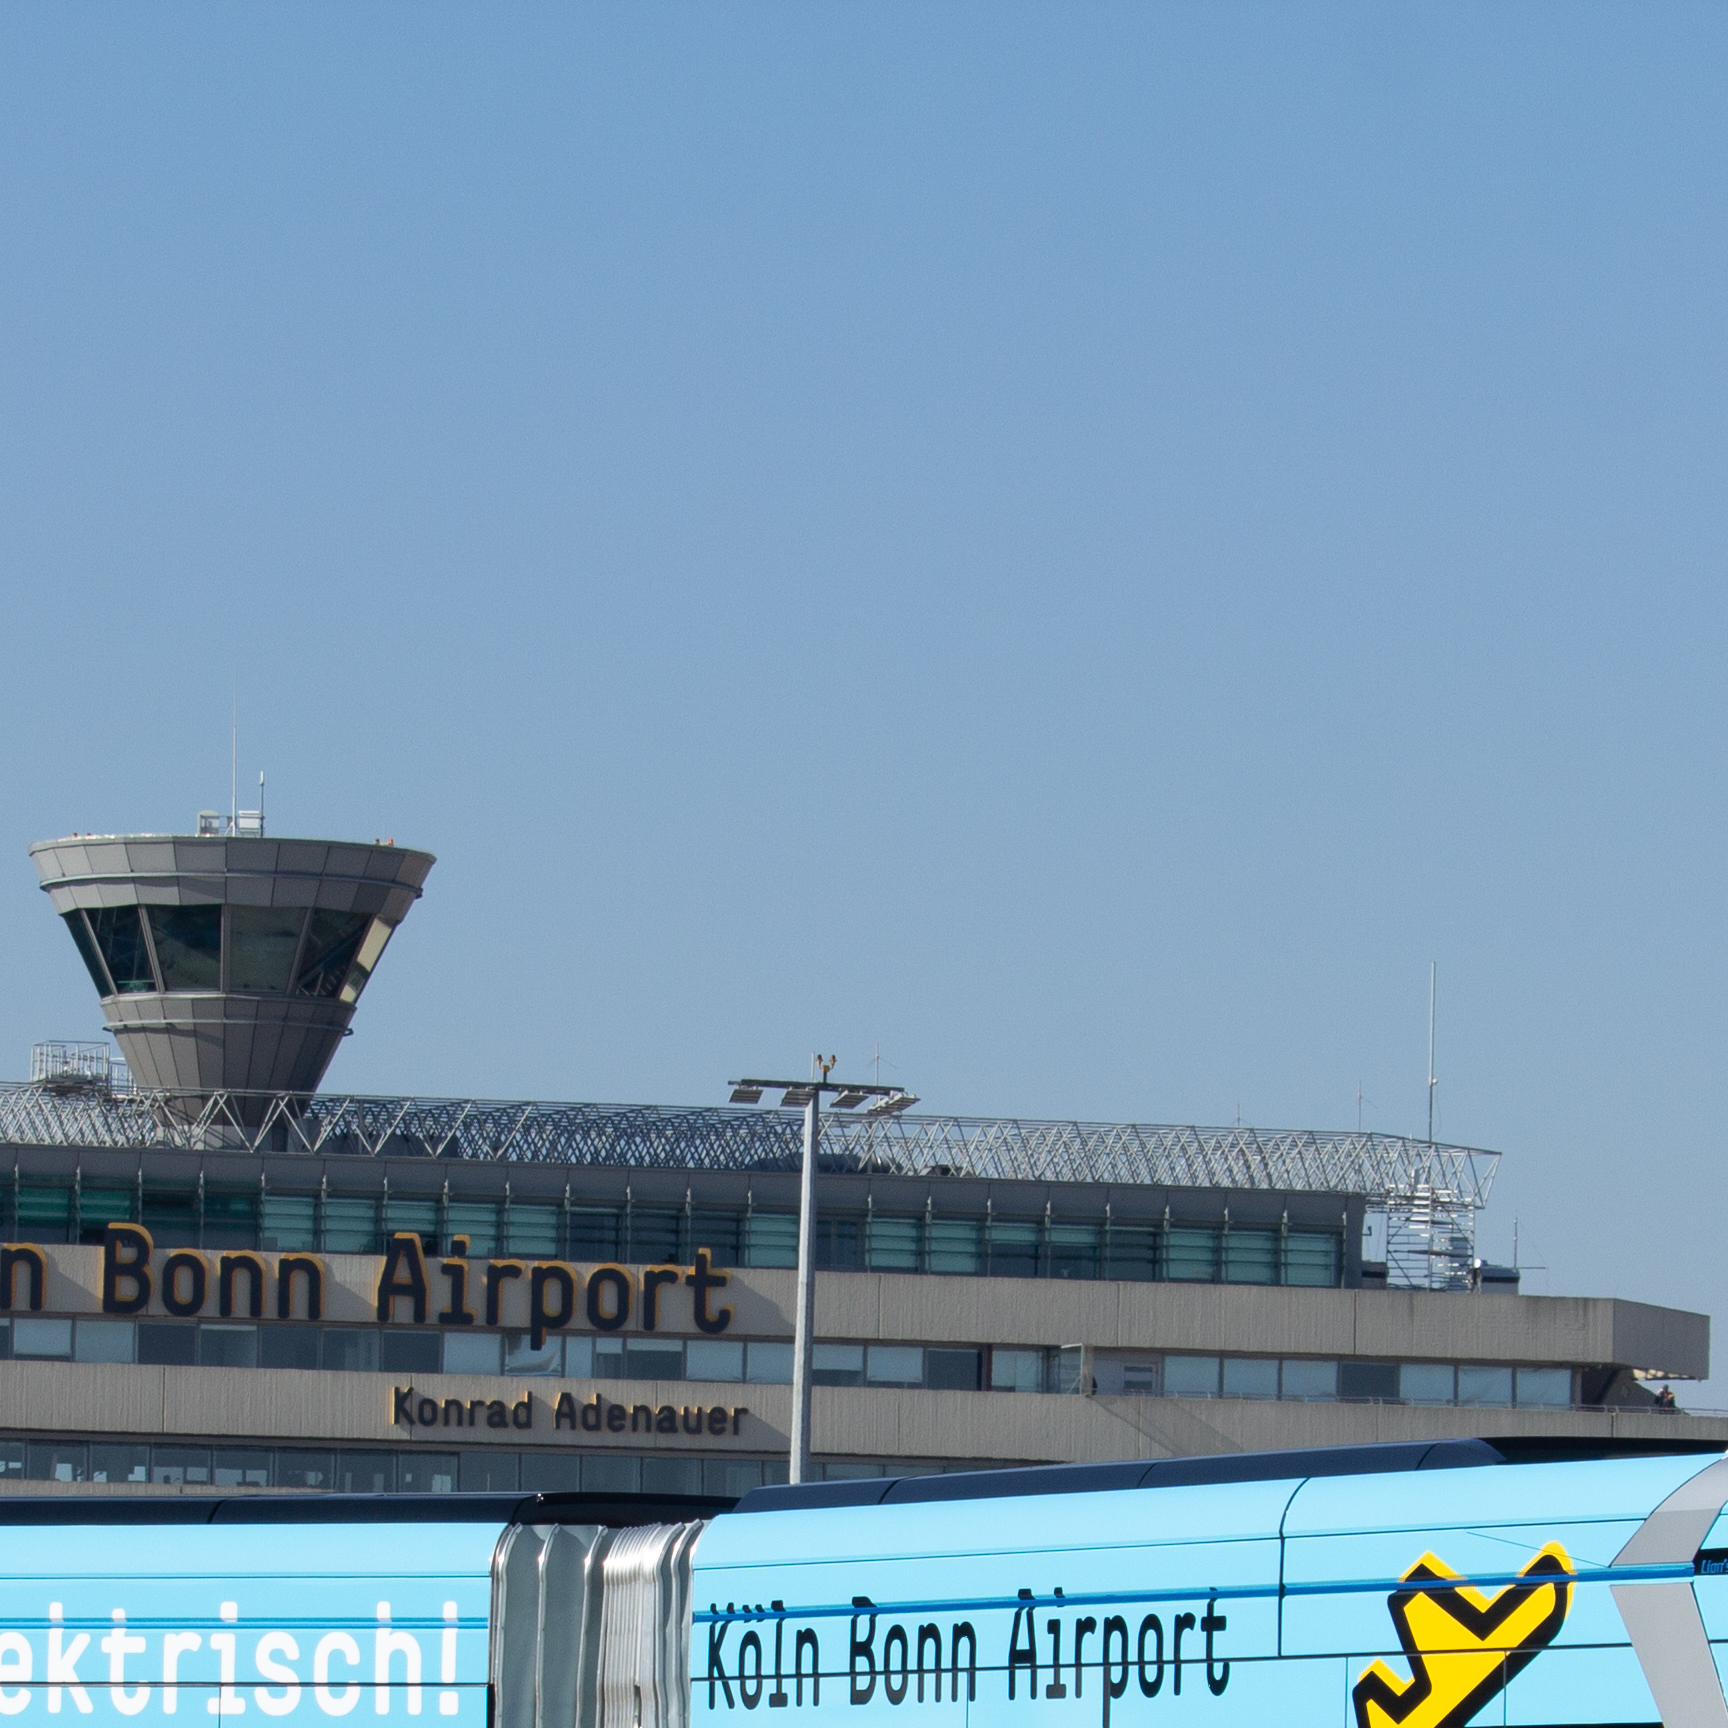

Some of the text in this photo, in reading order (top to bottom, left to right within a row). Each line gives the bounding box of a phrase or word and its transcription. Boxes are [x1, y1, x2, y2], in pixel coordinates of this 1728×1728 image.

[103, 1222, 324, 1320] Bonn
[377, 1232, 734, 1351] Airport
[392, 1386, 749, 1436] Konrad Adenauer
[708, 1600, 820, 1710] Köln
[849, 1596, 976, 1705] Bonn
